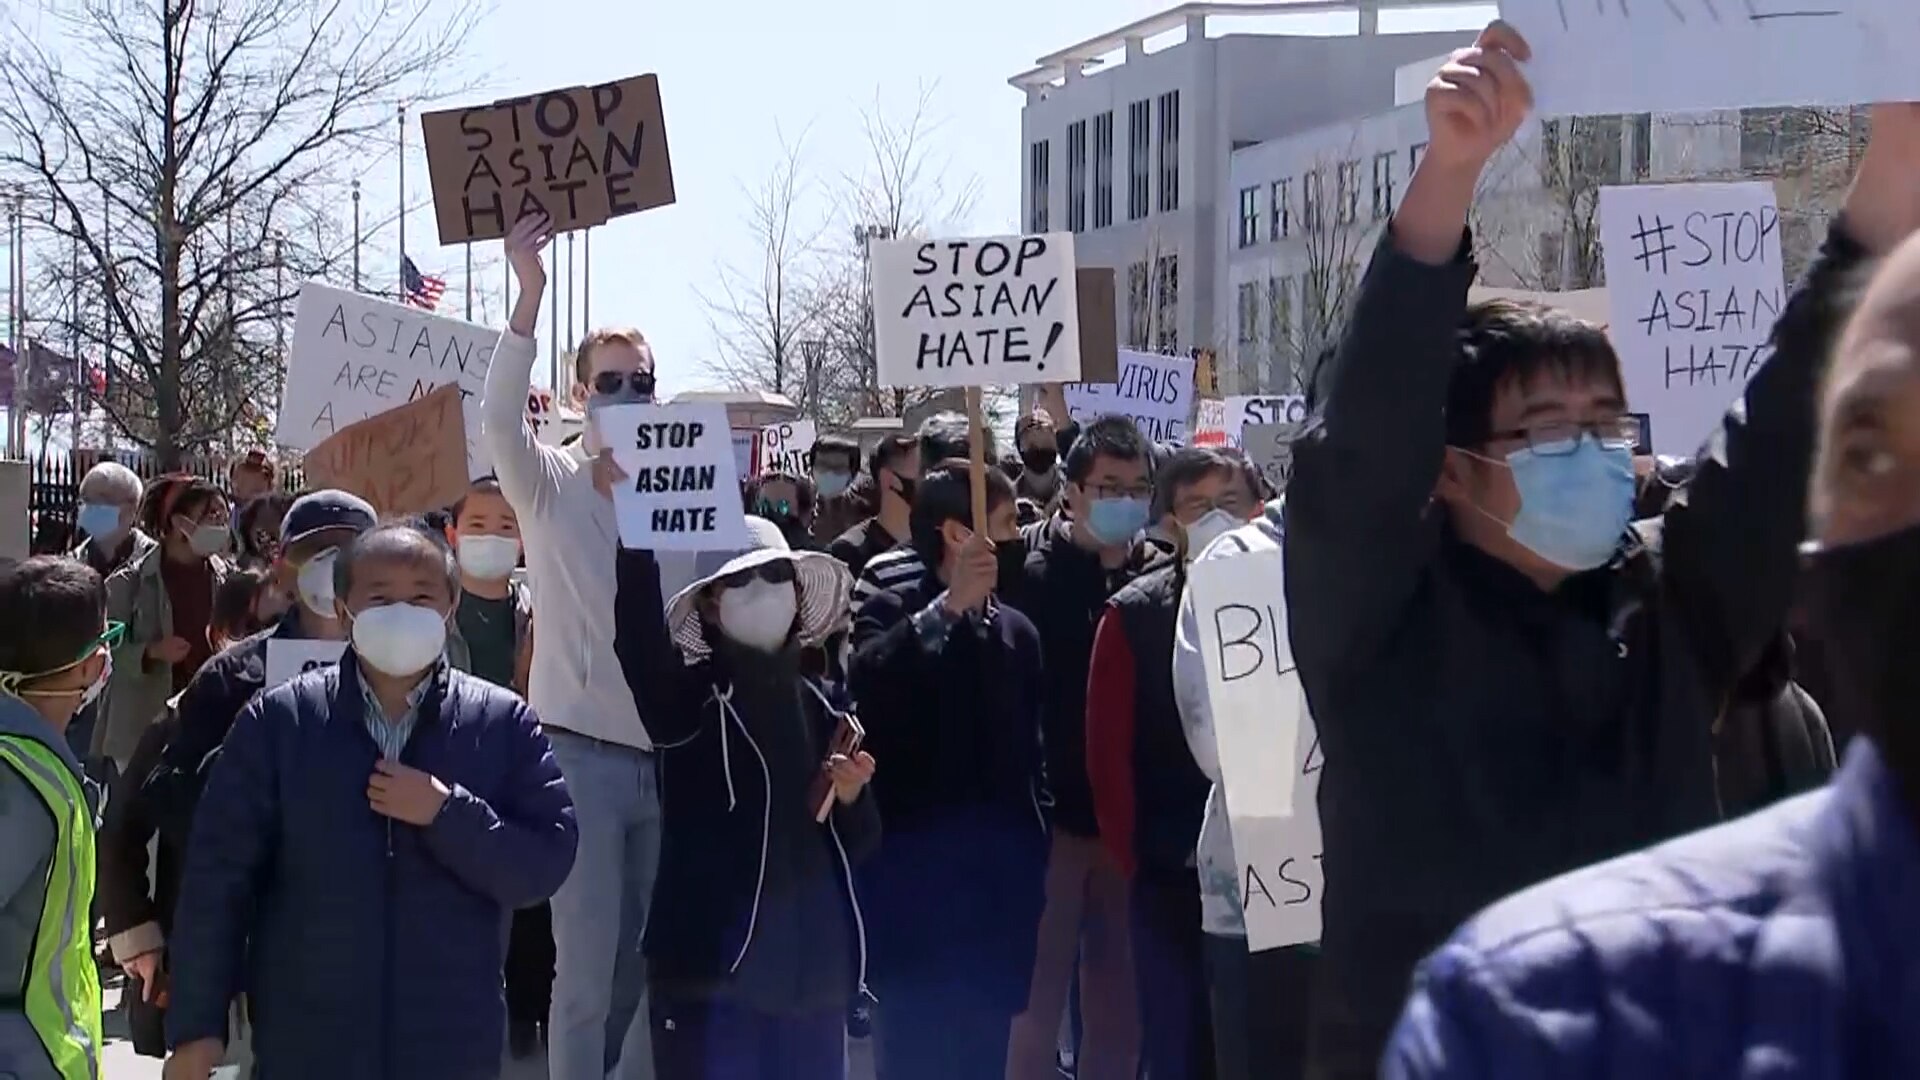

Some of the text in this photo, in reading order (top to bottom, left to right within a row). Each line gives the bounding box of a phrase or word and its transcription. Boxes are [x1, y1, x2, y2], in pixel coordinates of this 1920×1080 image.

[460, 85, 622, 151] STOP
[464, 121, 644, 191] ASIAN
[461, 172, 638, 236] HATE
[913, 237, 1046, 277] STOP
[1631, 205, 1777, 274] #STOP
[902, 277, 1058, 318] ASIAN
[1638, 285, 1779, 335] ASIAN
[322, 304, 495, 380] ASIANS
[916, 322, 1064, 371] HATE!
[333, 361, 398, 398] ARE
[1116, 364, 1180, 405] VIRUS
[312, 401, 335, 433] A
[1243, 398, 1306, 424] STO
[636, 421, 704, 450] STOP
[635, 465, 715, 494] ASIAN
[651, 507, 716, 533] HATE
